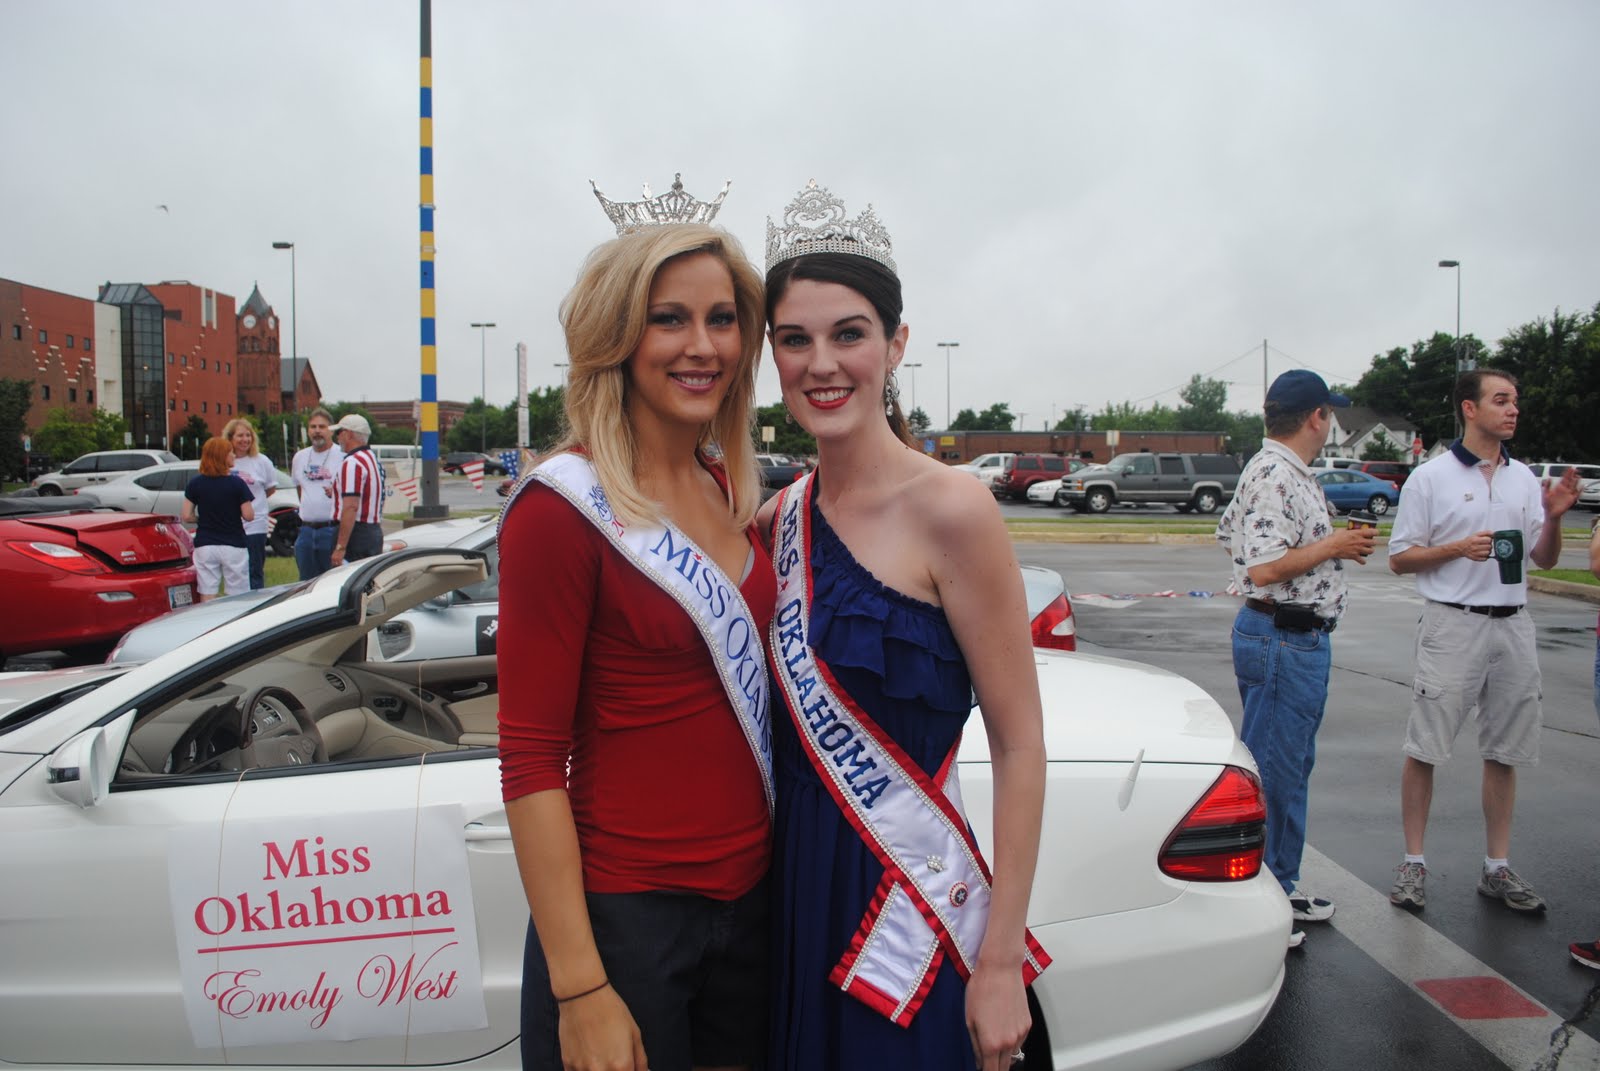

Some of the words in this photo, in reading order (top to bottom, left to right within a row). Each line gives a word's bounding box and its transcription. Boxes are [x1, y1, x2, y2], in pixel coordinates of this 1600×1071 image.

[777, 598, 892, 809] OKLAHOMA
[262, 836, 371, 880] Miss
[194, 886, 452, 935] Oklahoma
[203, 969, 343, 1029] Emoly
[357, 942, 458, 1007] West
